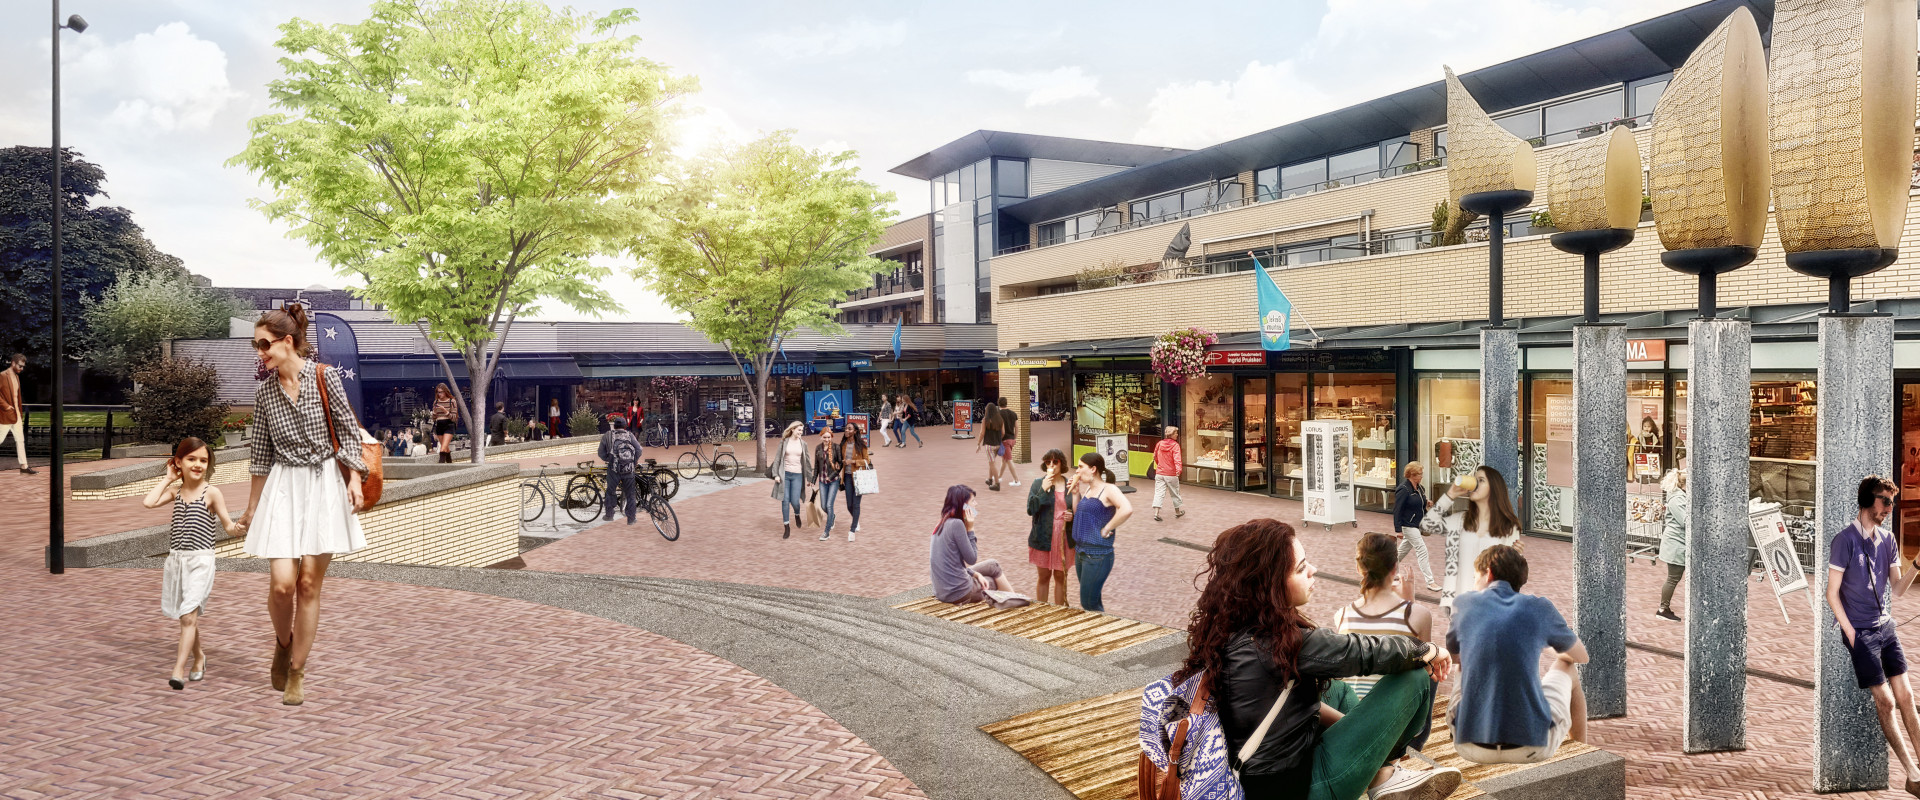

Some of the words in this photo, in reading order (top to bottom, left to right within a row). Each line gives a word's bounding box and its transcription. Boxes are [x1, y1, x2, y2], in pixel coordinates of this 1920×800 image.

[1626, 341, 1648, 360] MA
[743, 363, 783, 375] Alrt
[787, 362, 817, 376] Heijn
[1332, 425, 1349, 433] LORUS
